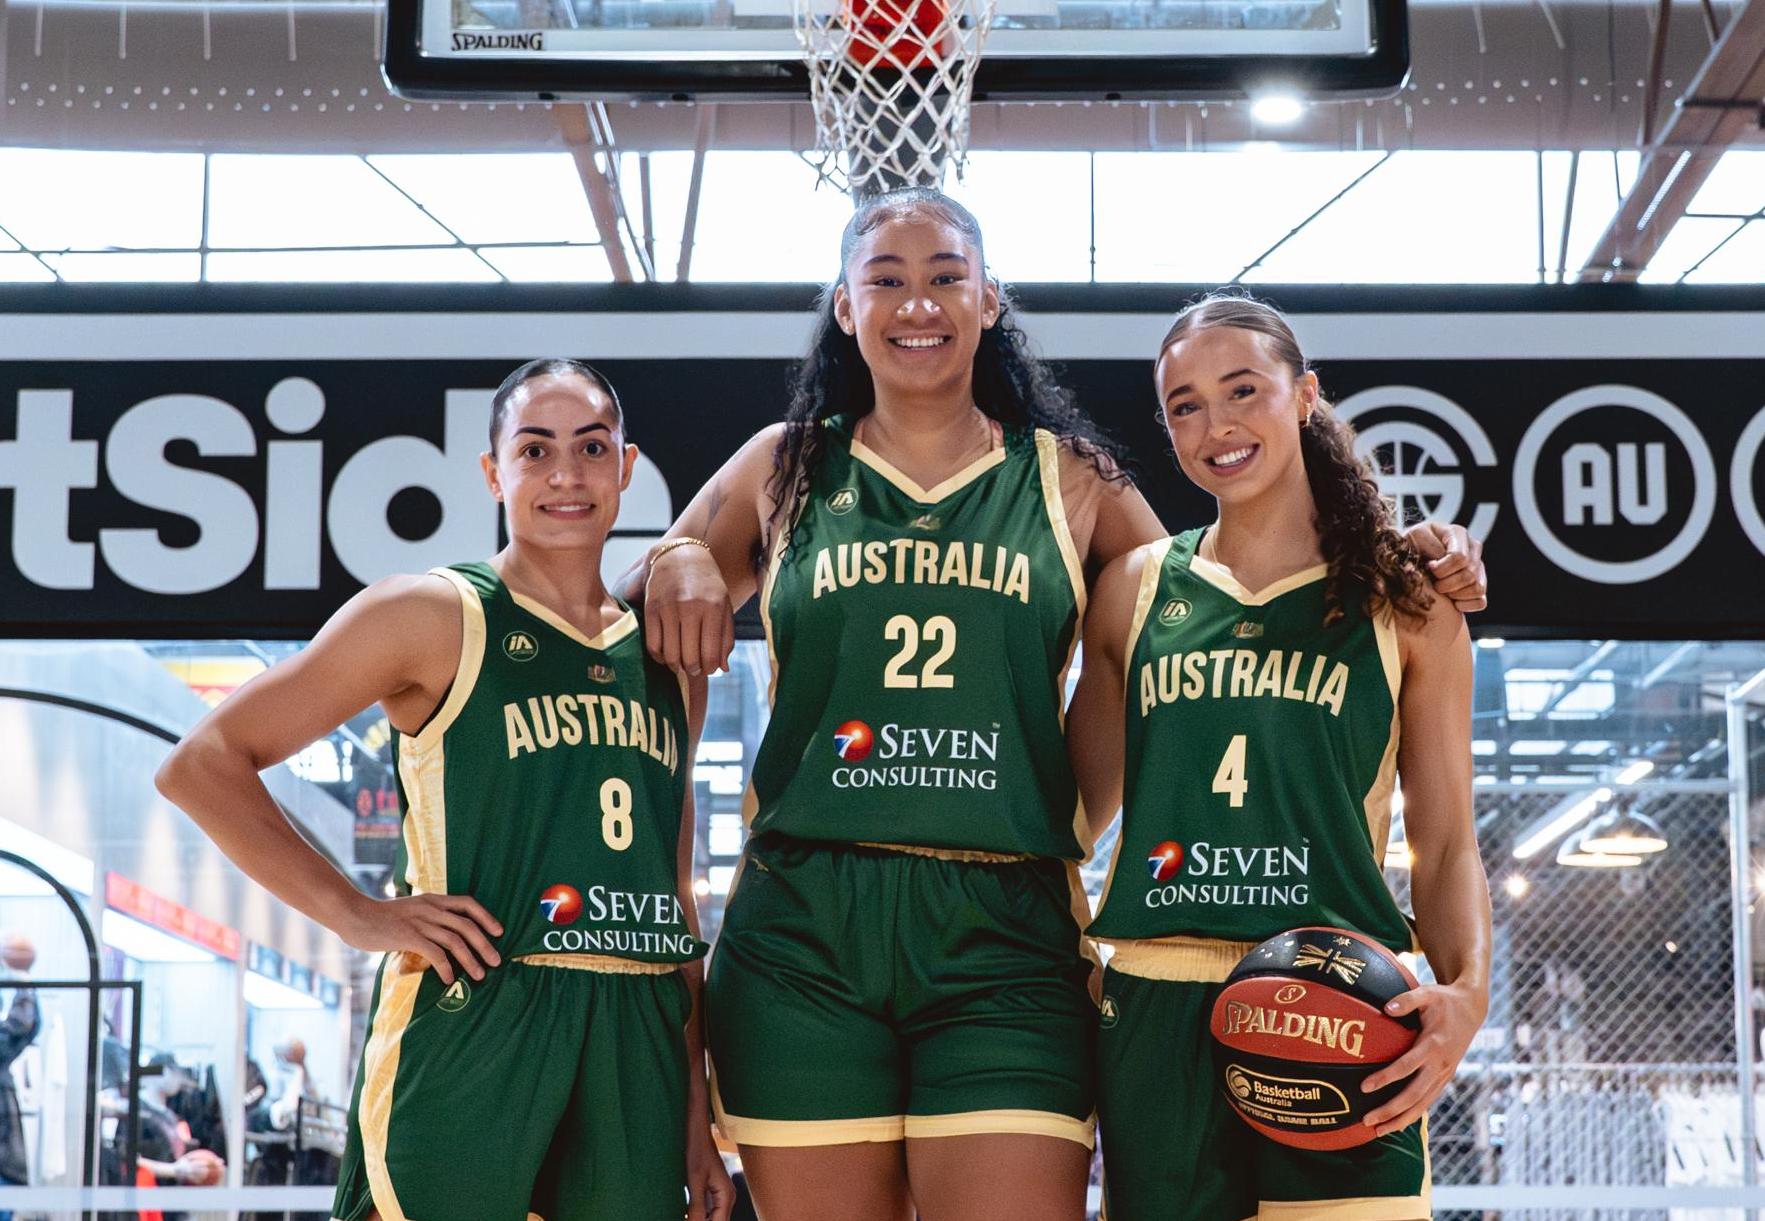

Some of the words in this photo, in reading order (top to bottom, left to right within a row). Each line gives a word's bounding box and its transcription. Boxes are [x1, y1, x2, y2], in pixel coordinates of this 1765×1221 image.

[451, 32, 543, 51] SPALDING
[1562, 443, 1667, 526] AU
[813, 538, 1031, 604] AUSTRALIA
[884, 614, 957, 689] 22
[1140, 649, 1350, 718] AUSTRALIA
[879, 724, 1000, 761] SEVEN
[832, 766, 997, 790] CONSULTING
[1211, 735, 1248, 808] 4
[599, 777, 634, 851] 8
[1188, 842, 1309, 877] SEVEN
[1145, 883, 1309, 908] CONSULTING
[543, 929, 694, 955] CONSULTING
[1222, 999, 1366, 1058] SPALDING
[1254, 1081, 1321, 1100] Basketball
[1255, 1093, 1293, 1107] Australia
